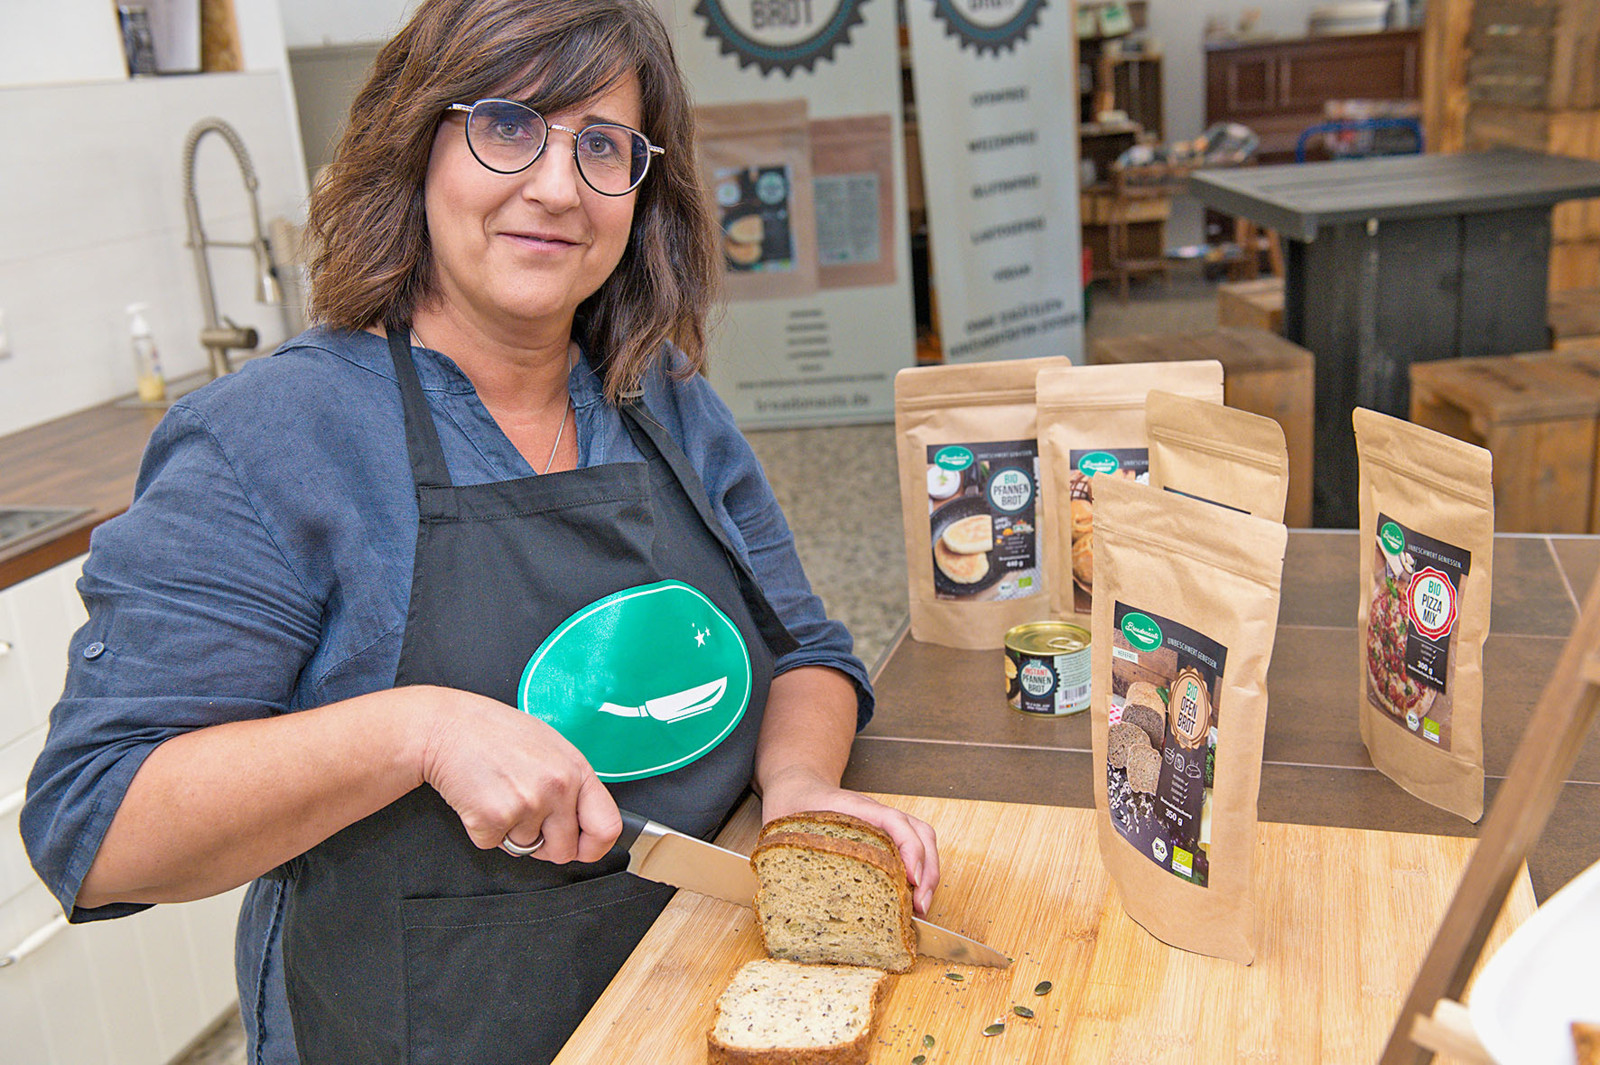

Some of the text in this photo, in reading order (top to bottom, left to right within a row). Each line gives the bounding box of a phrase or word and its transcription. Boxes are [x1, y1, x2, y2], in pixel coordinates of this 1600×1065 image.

[1004, 474, 1018, 484] BIO
[993, 484, 1029, 496] PFANNEN
[1001, 495, 1022, 506] BROT
[1428, 580, 1441, 596] BIO
[1421, 593, 1442, 614] PIZZA
[1422, 608, 1438, 626] MIX
[1167, 637, 1198, 657] UNBESCHWERT
[1022, 674, 1052, 684] PFANNEN
[1024, 667, 1048, 676] INSTANT
[1028, 683, 1045, 693] BROT
[1186, 681, 1198, 701] BIO
[1181, 696, 1198, 720] OFEN
[1178, 712, 1196, 735] BROT
[1164, 808, 1183, 827] 350 g
